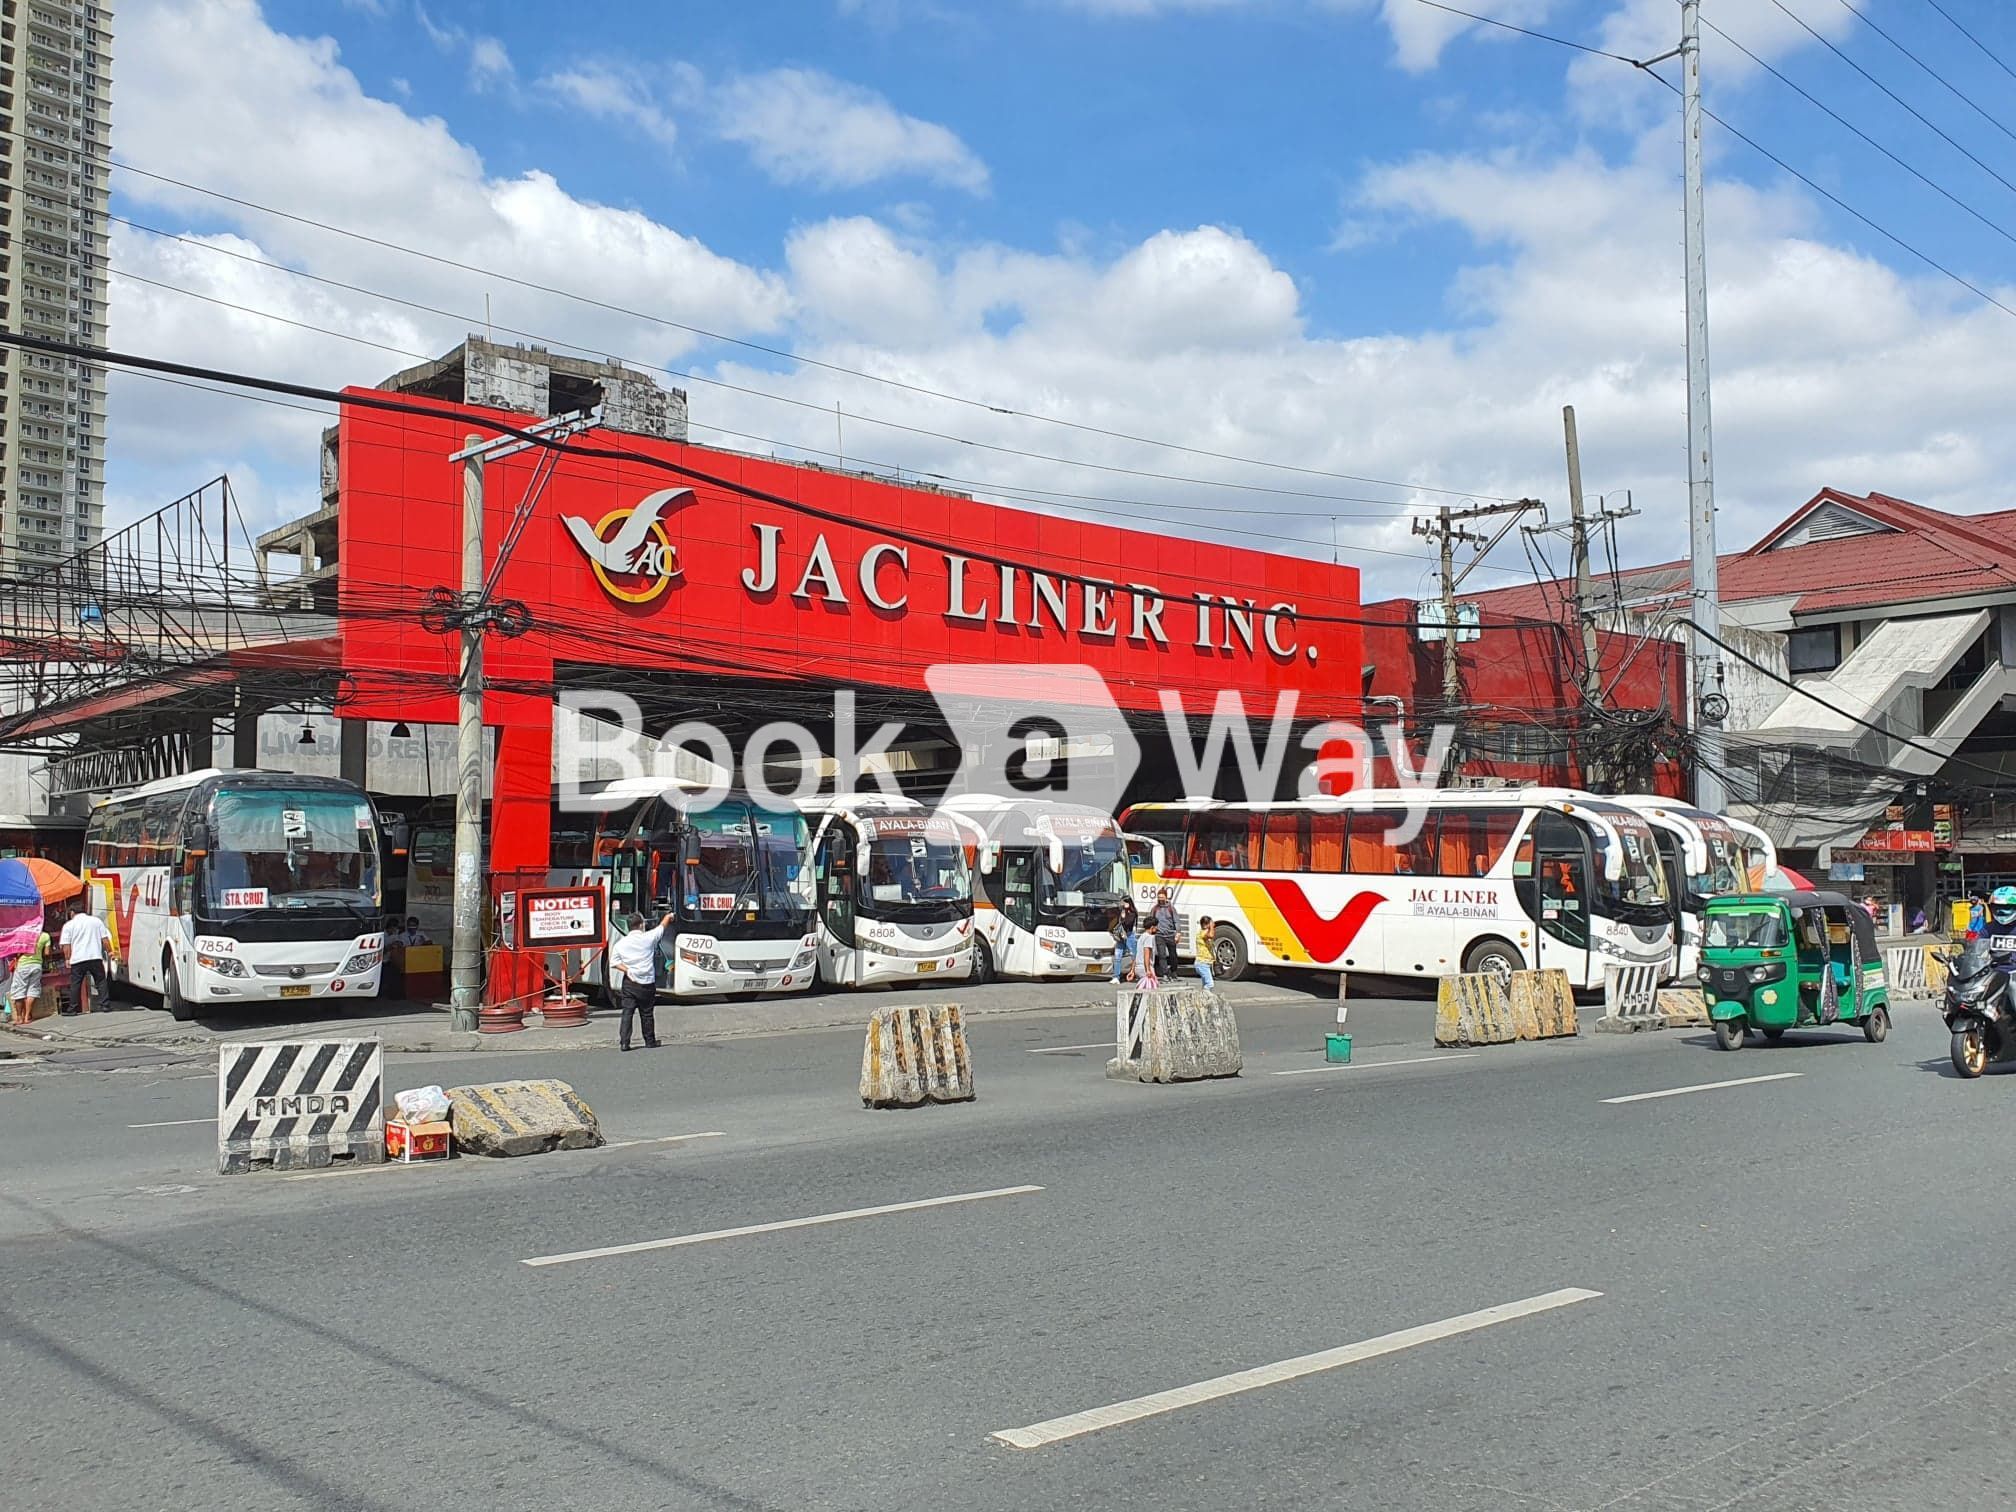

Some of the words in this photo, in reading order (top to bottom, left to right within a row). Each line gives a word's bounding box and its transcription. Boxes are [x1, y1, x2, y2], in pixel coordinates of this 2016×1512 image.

[740, 523, 909, 610] JAC
[943, 554, 1170, 645] LINER
[1192, 591, 1319, 660] INC.
[243, 891, 265, 905] CRUZ
[1140, 886, 1174, 900] 880
[1408, 888, 1438, 903] JAC
[1443, 889, 1499, 905] LINER
[533, 897, 589, 911] NOTICE
[868, 928, 896, 938] 8808
[1044, 928, 1066, 939] 1833
[199, 939, 234, 953] 7854
[358, 937, 382, 950] LLI
[685, 937, 713, 949] 7870
[804, 937, 817, 947] LL
[1995, 938, 2016, 949] H8
[255, 1095, 349, 1117] MMDA
